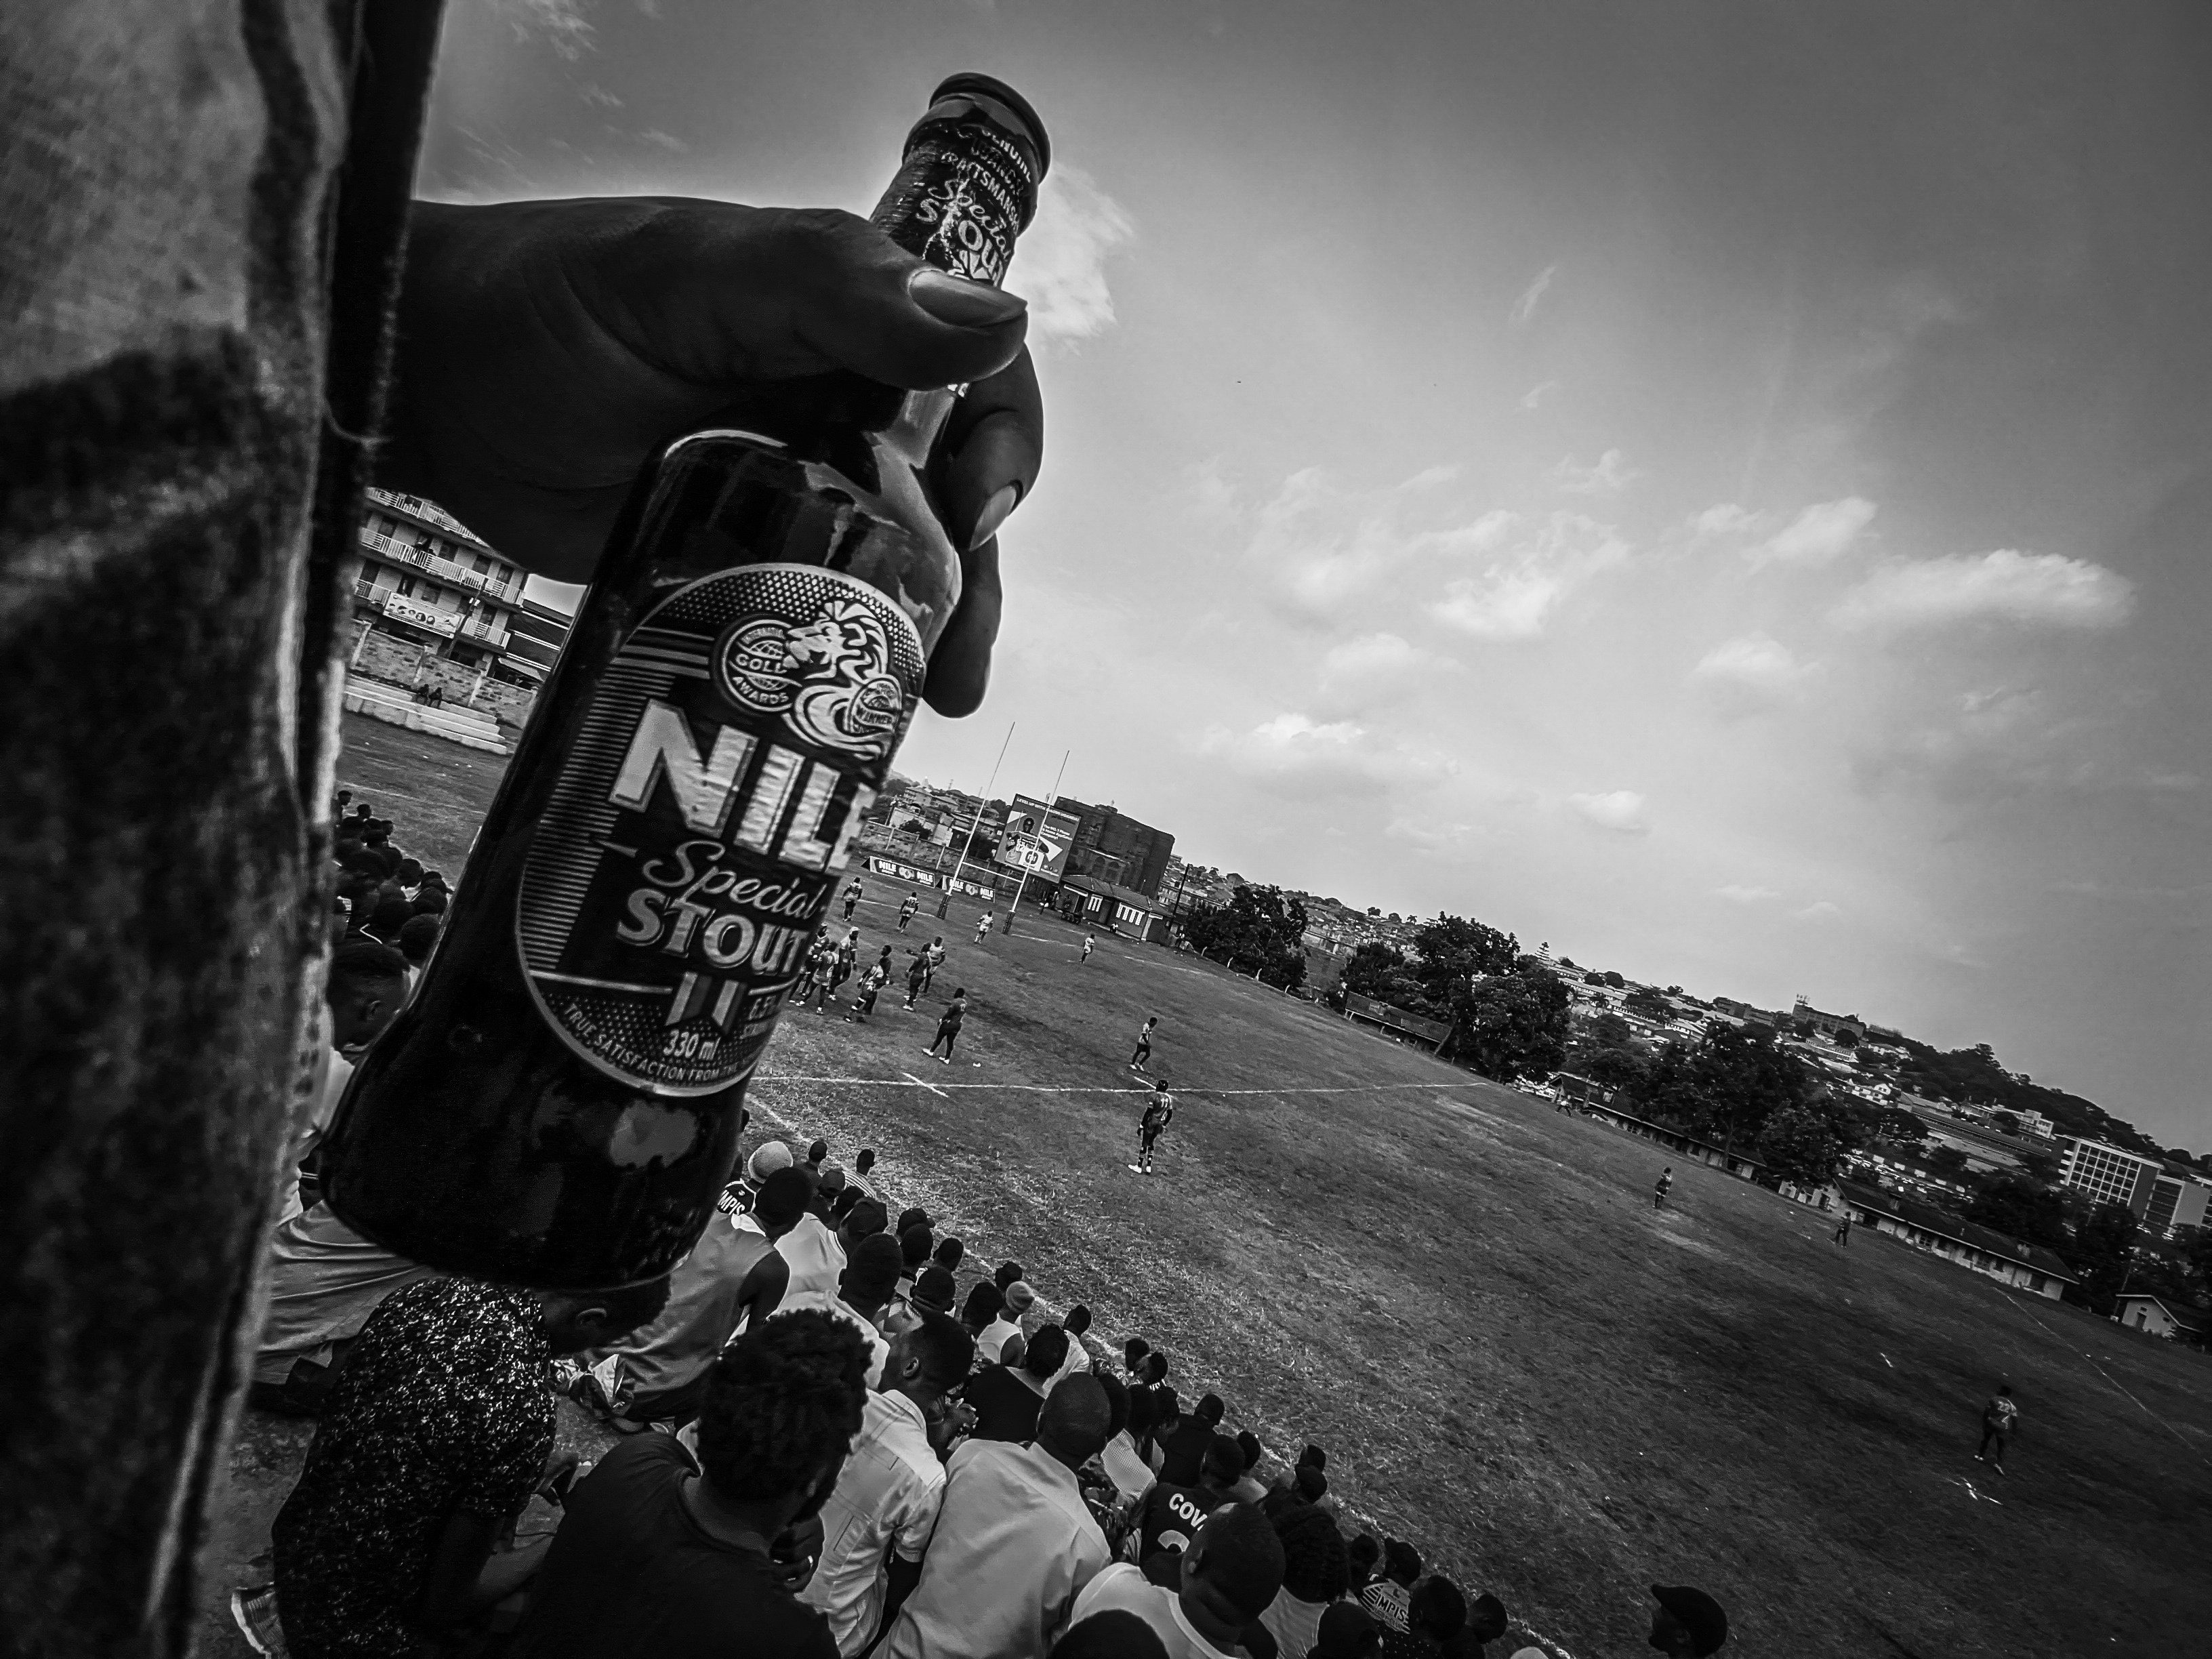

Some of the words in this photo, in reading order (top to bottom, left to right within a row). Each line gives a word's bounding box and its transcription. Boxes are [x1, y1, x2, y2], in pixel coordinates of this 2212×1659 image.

[732, 676, 789, 705] AWARDS
[643, 840, 827, 920] Special
[878, 860, 897, 872] NILE
[916, 872, 933, 883] NILE
[979, 886, 994, 898] NILE
[616, 888, 810, 977] STOUT
[564, 1003, 597, 1038] TRUE
[594, 1033, 685, 1080] SATISFACTION
[687, 1068, 720, 1082] FROM
[663, 1029, 699, 1059] 330
[699, 1036, 721, 1061] ml
[1374, 1593, 1408, 1622] IMPIS
